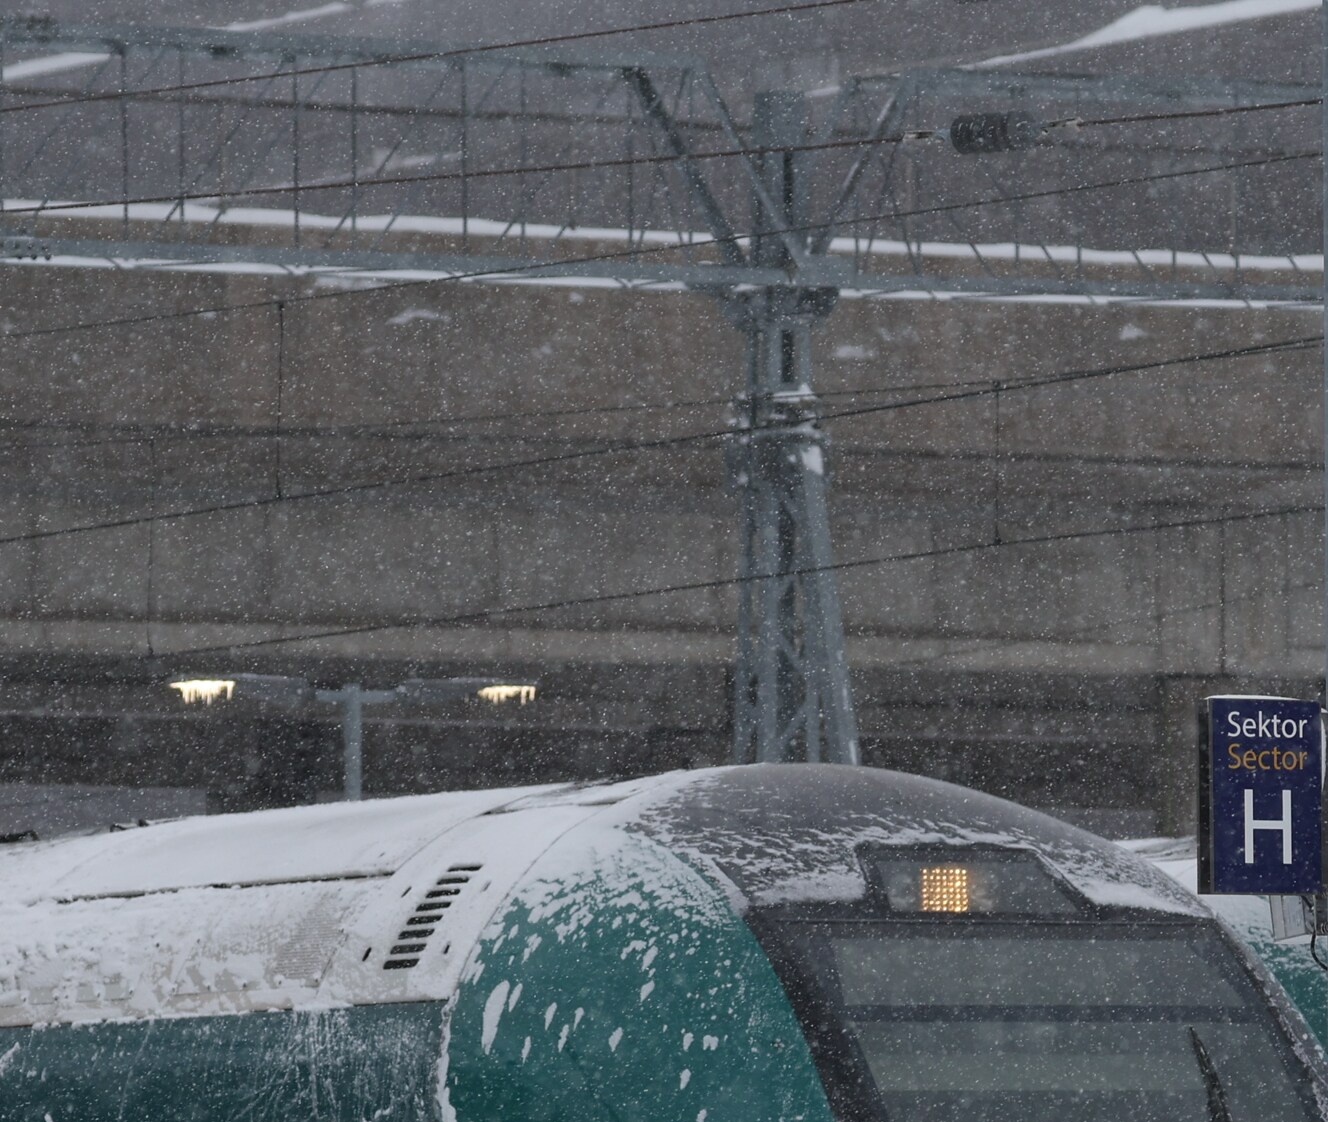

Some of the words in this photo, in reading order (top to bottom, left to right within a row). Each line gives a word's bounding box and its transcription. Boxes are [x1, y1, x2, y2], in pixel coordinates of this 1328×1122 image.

[1227, 711, 1308, 740] Sektor
[1228, 744, 1308, 771] Sector
[1244, 789, 1293, 865] H
